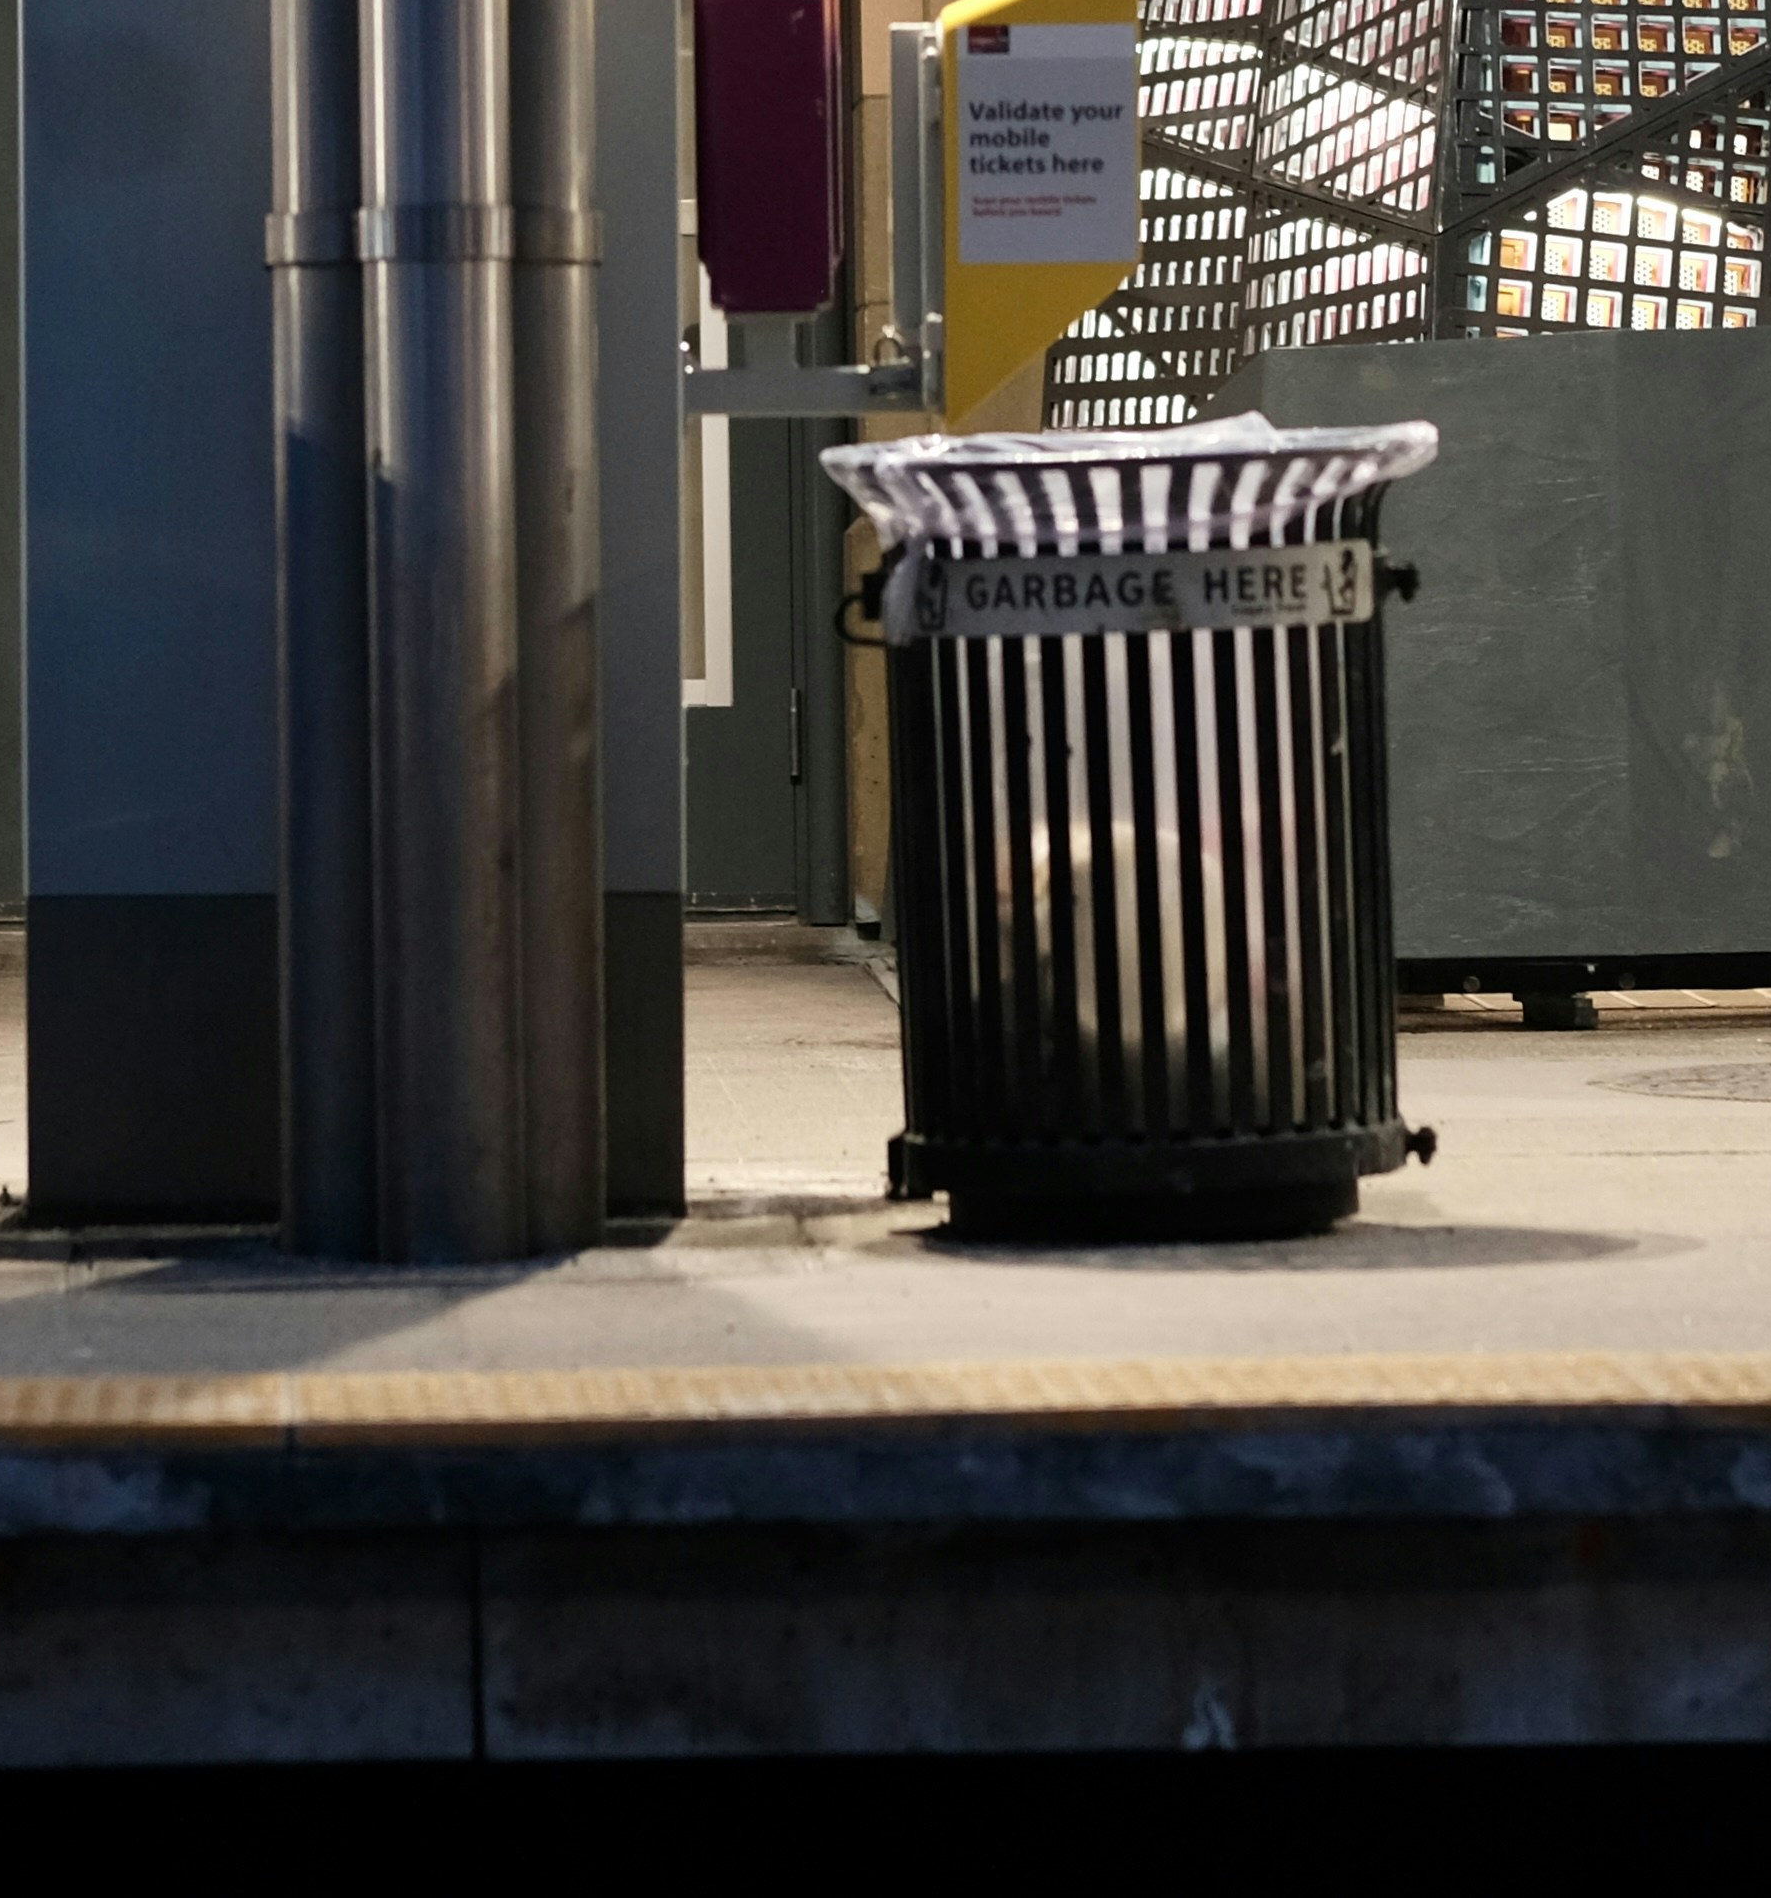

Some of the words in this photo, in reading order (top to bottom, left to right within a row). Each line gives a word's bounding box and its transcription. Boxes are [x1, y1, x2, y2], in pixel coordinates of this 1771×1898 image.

[968, 100, 1065, 122] Validate
[1071, 104, 1124, 125] your
[969, 127, 1051, 149] mobile
[969, 155, 1047, 175] tickets
[1052, 153, 1105, 175] here
[965, 568, 1175, 612] GARBAGE
[1204, 563, 1308, 604] HERE
